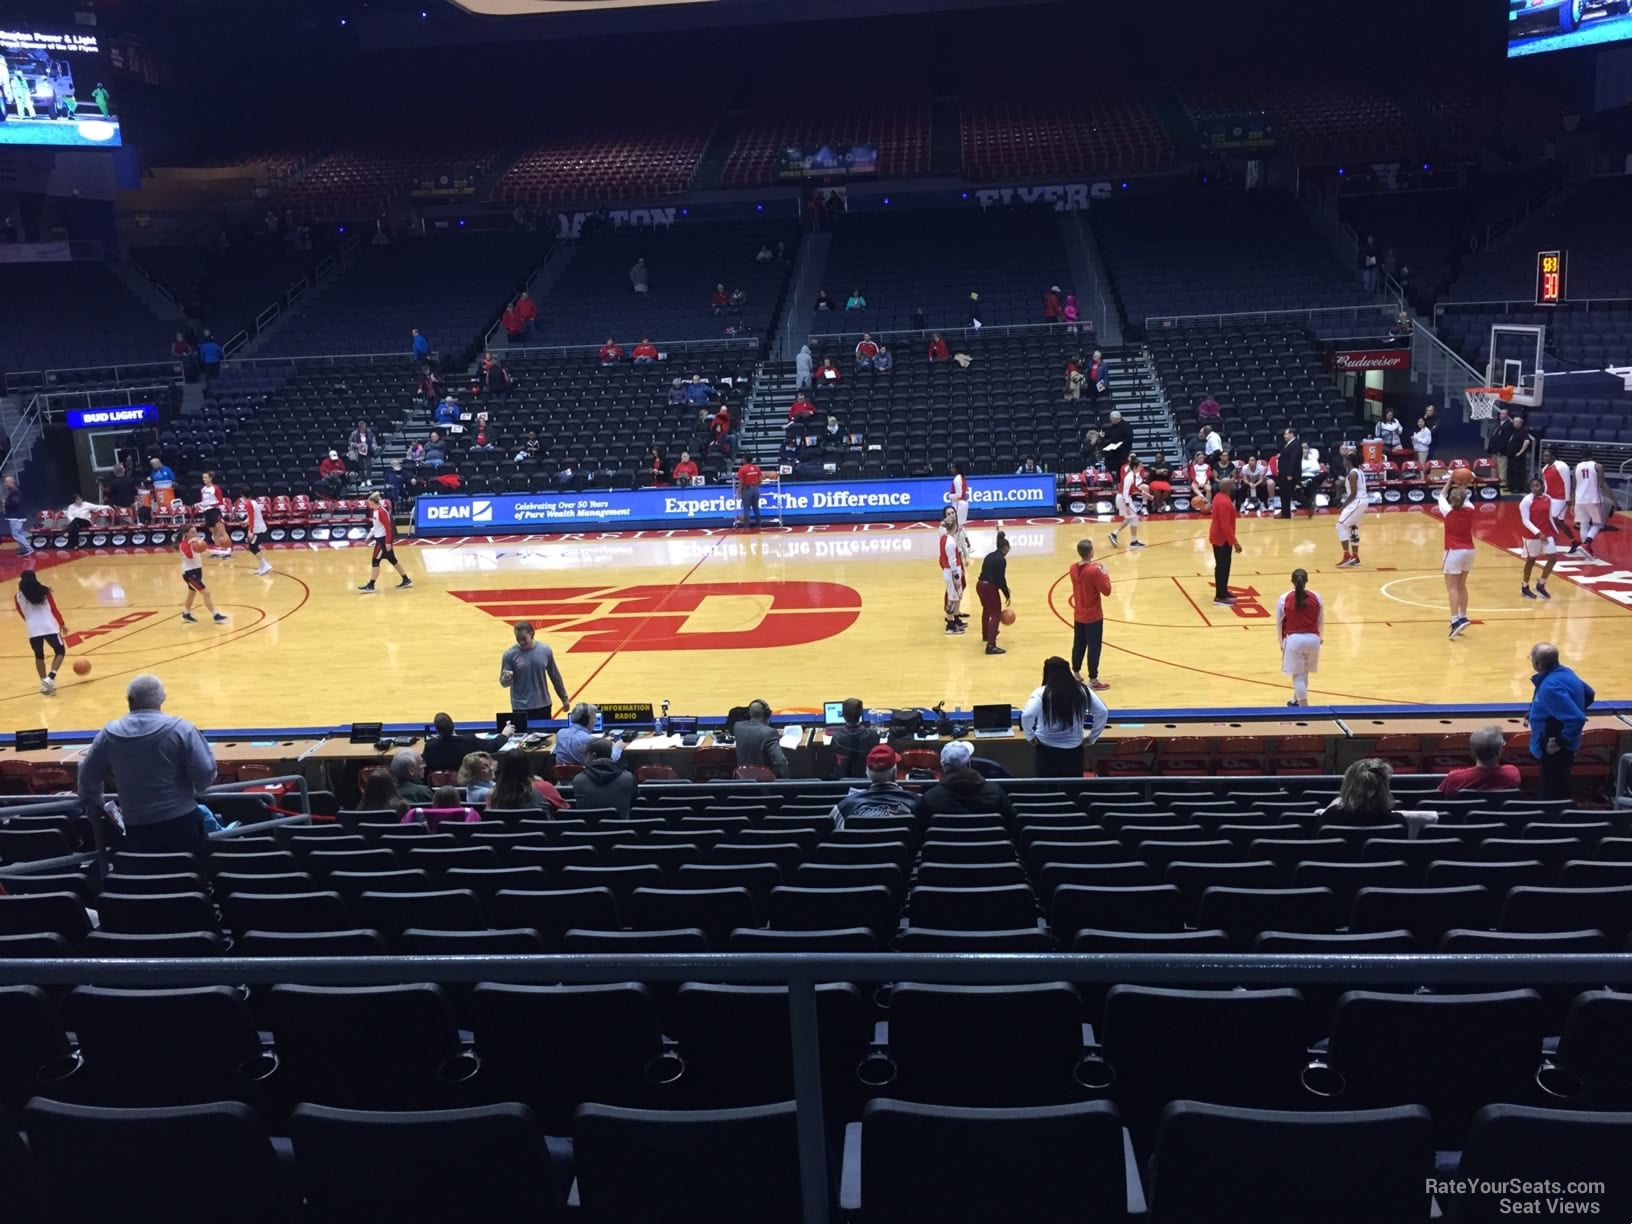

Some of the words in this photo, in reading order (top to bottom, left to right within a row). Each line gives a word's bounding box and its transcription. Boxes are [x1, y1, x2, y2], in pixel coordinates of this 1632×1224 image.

[73, 35, 97, 45] Light
[1544, 273, 1558, 298] 30
[1336, 355, 1401, 368] Budweiser
[83, 413, 109, 423] BUD
[109, 410, 144, 421] LIGHT
[1581, 469, 1590, 479] 11
[514, 502, 556, 511] Celebrating
[558, 501, 576, 509] Over
[664, 495, 767, 516] Experiee
[773, 493, 808, 508] The
[812, 491, 911, 508] Difference
[427, 506, 470, 519] DEAN
[514, 511, 524, 520] of
[546, 509, 575, 518] Wealth
[576, 508, 630, 518] Management
[852, 517, 1112, 531] DATON
[614, 712, 637, 720] RADIO
